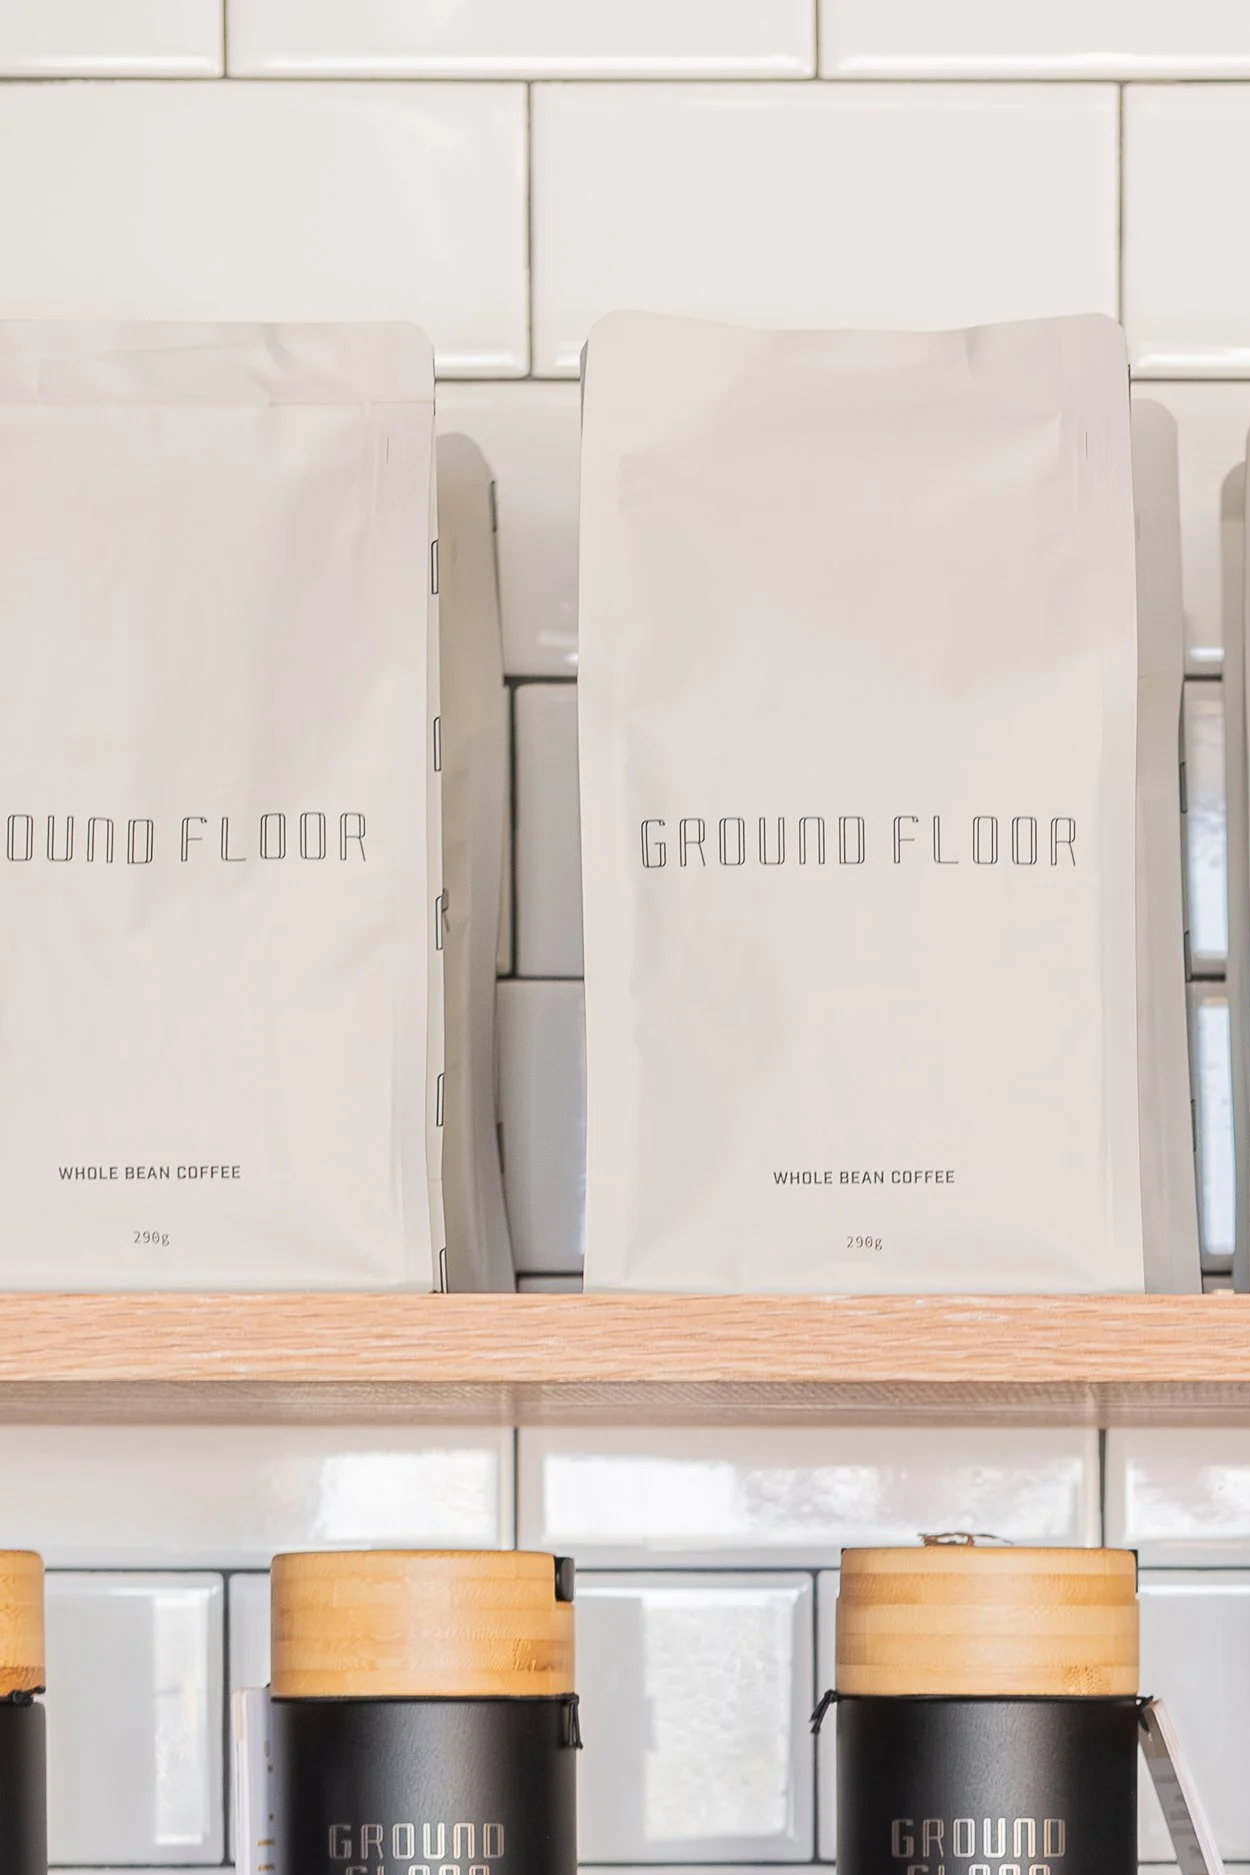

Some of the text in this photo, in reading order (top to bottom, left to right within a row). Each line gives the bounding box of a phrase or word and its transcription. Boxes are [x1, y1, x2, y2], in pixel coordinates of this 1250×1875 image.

[6, 813, 365, 864] OUND FLOOR
[641, 816, 1075, 868] GROUND FLOOR
[58, 1165, 241, 1180] WHOLE BEAN COFFEE
[773, 1170, 955, 1185] WHOLE BEAN COFFEE
[134, 1231, 170, 1247] 290g
[846, 1235, 883, 1252] 290g
[329, 1823, 504, 1859] GROUND
[891, 1817, 1066, 1858] GROUND
